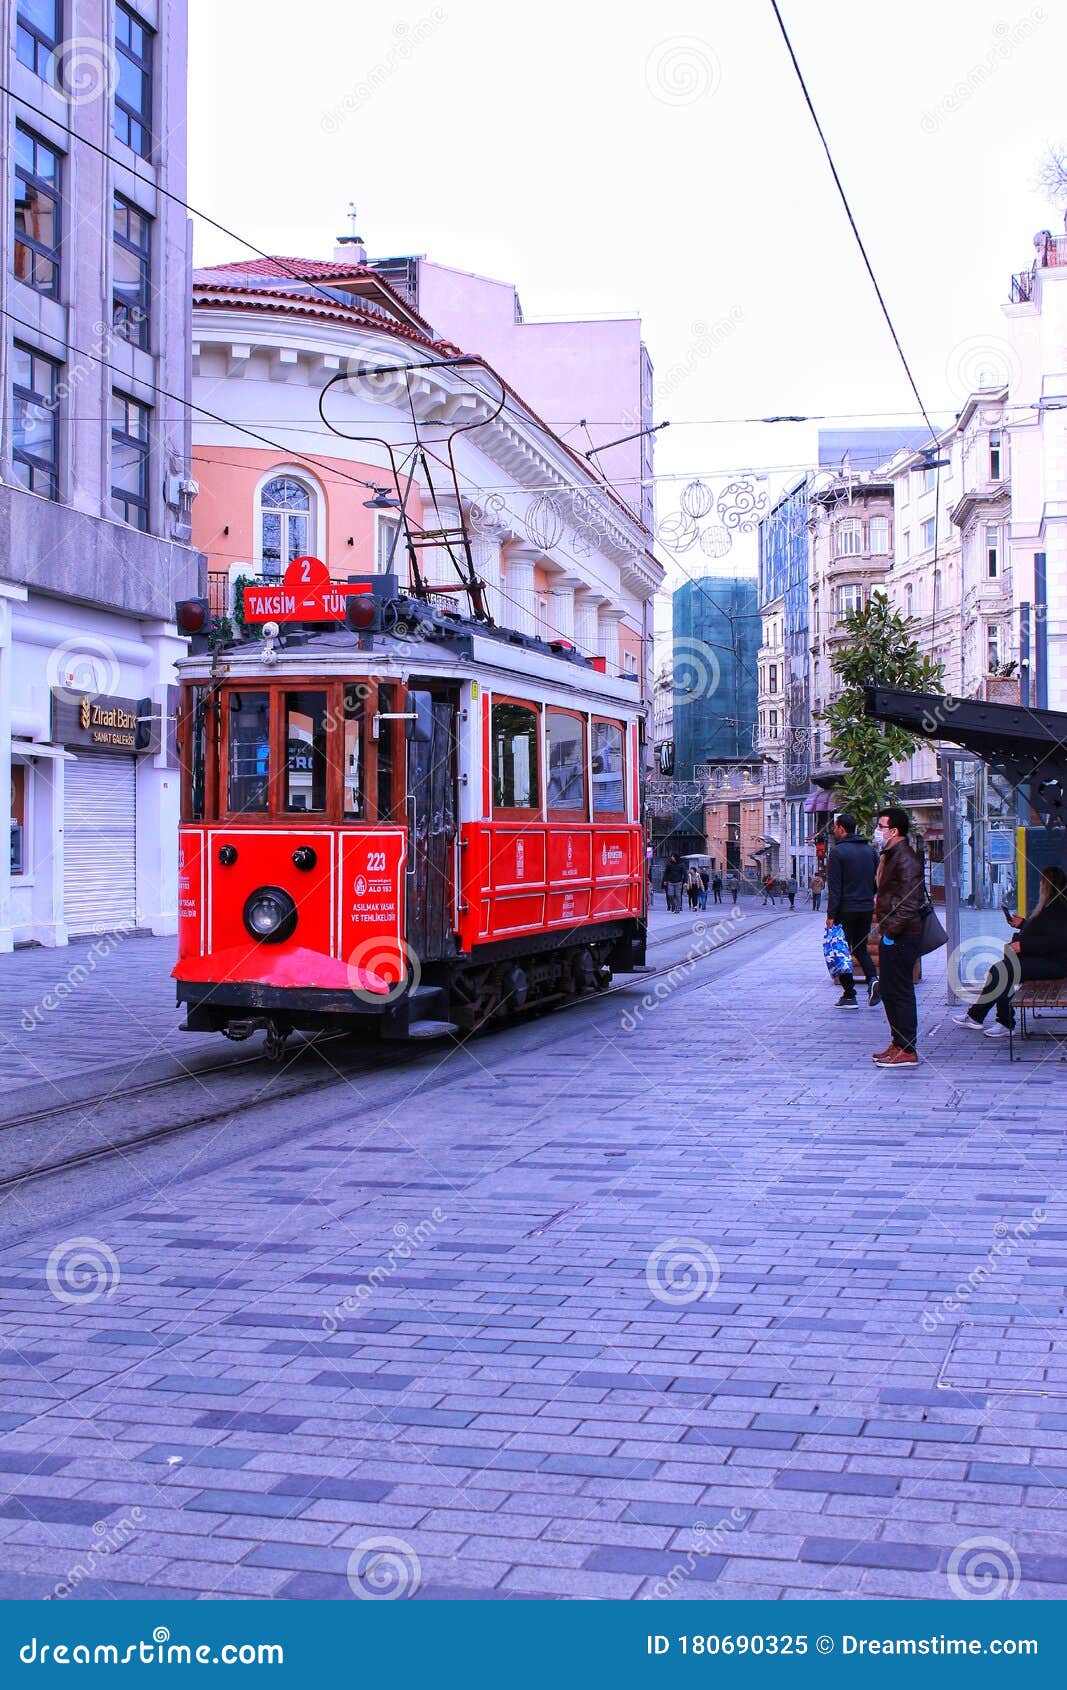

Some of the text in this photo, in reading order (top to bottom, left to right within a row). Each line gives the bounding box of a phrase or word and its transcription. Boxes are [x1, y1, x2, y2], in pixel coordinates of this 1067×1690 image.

[301, 560, 310, 582] 2
[249, 592, 295, 614] TAKSİM
[93, 705, 116, 727] Ziraat
[367, 852, 386, 871] 223
[380, 903, 395, 911] YASAK
[351, 914, 359, 922] VE
